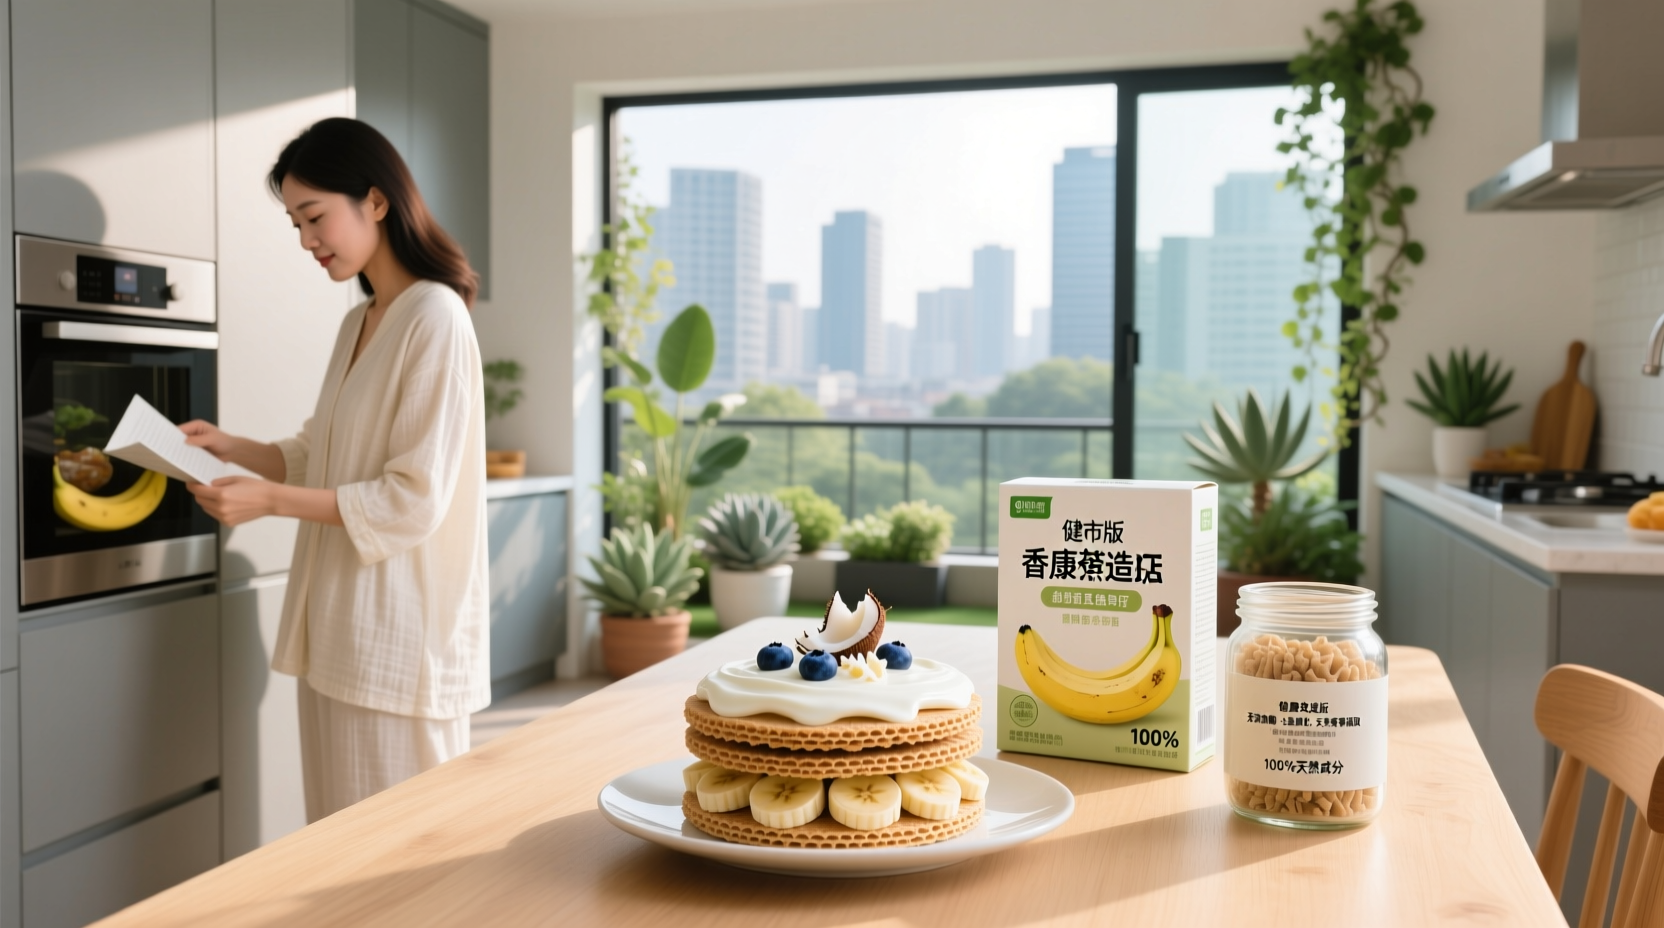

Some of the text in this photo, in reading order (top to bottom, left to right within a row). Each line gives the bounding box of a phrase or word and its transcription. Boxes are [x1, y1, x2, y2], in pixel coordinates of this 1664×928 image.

[1062, 518, 1124, 544] 健市版
[1130, 728, 1179, 748] 100%
